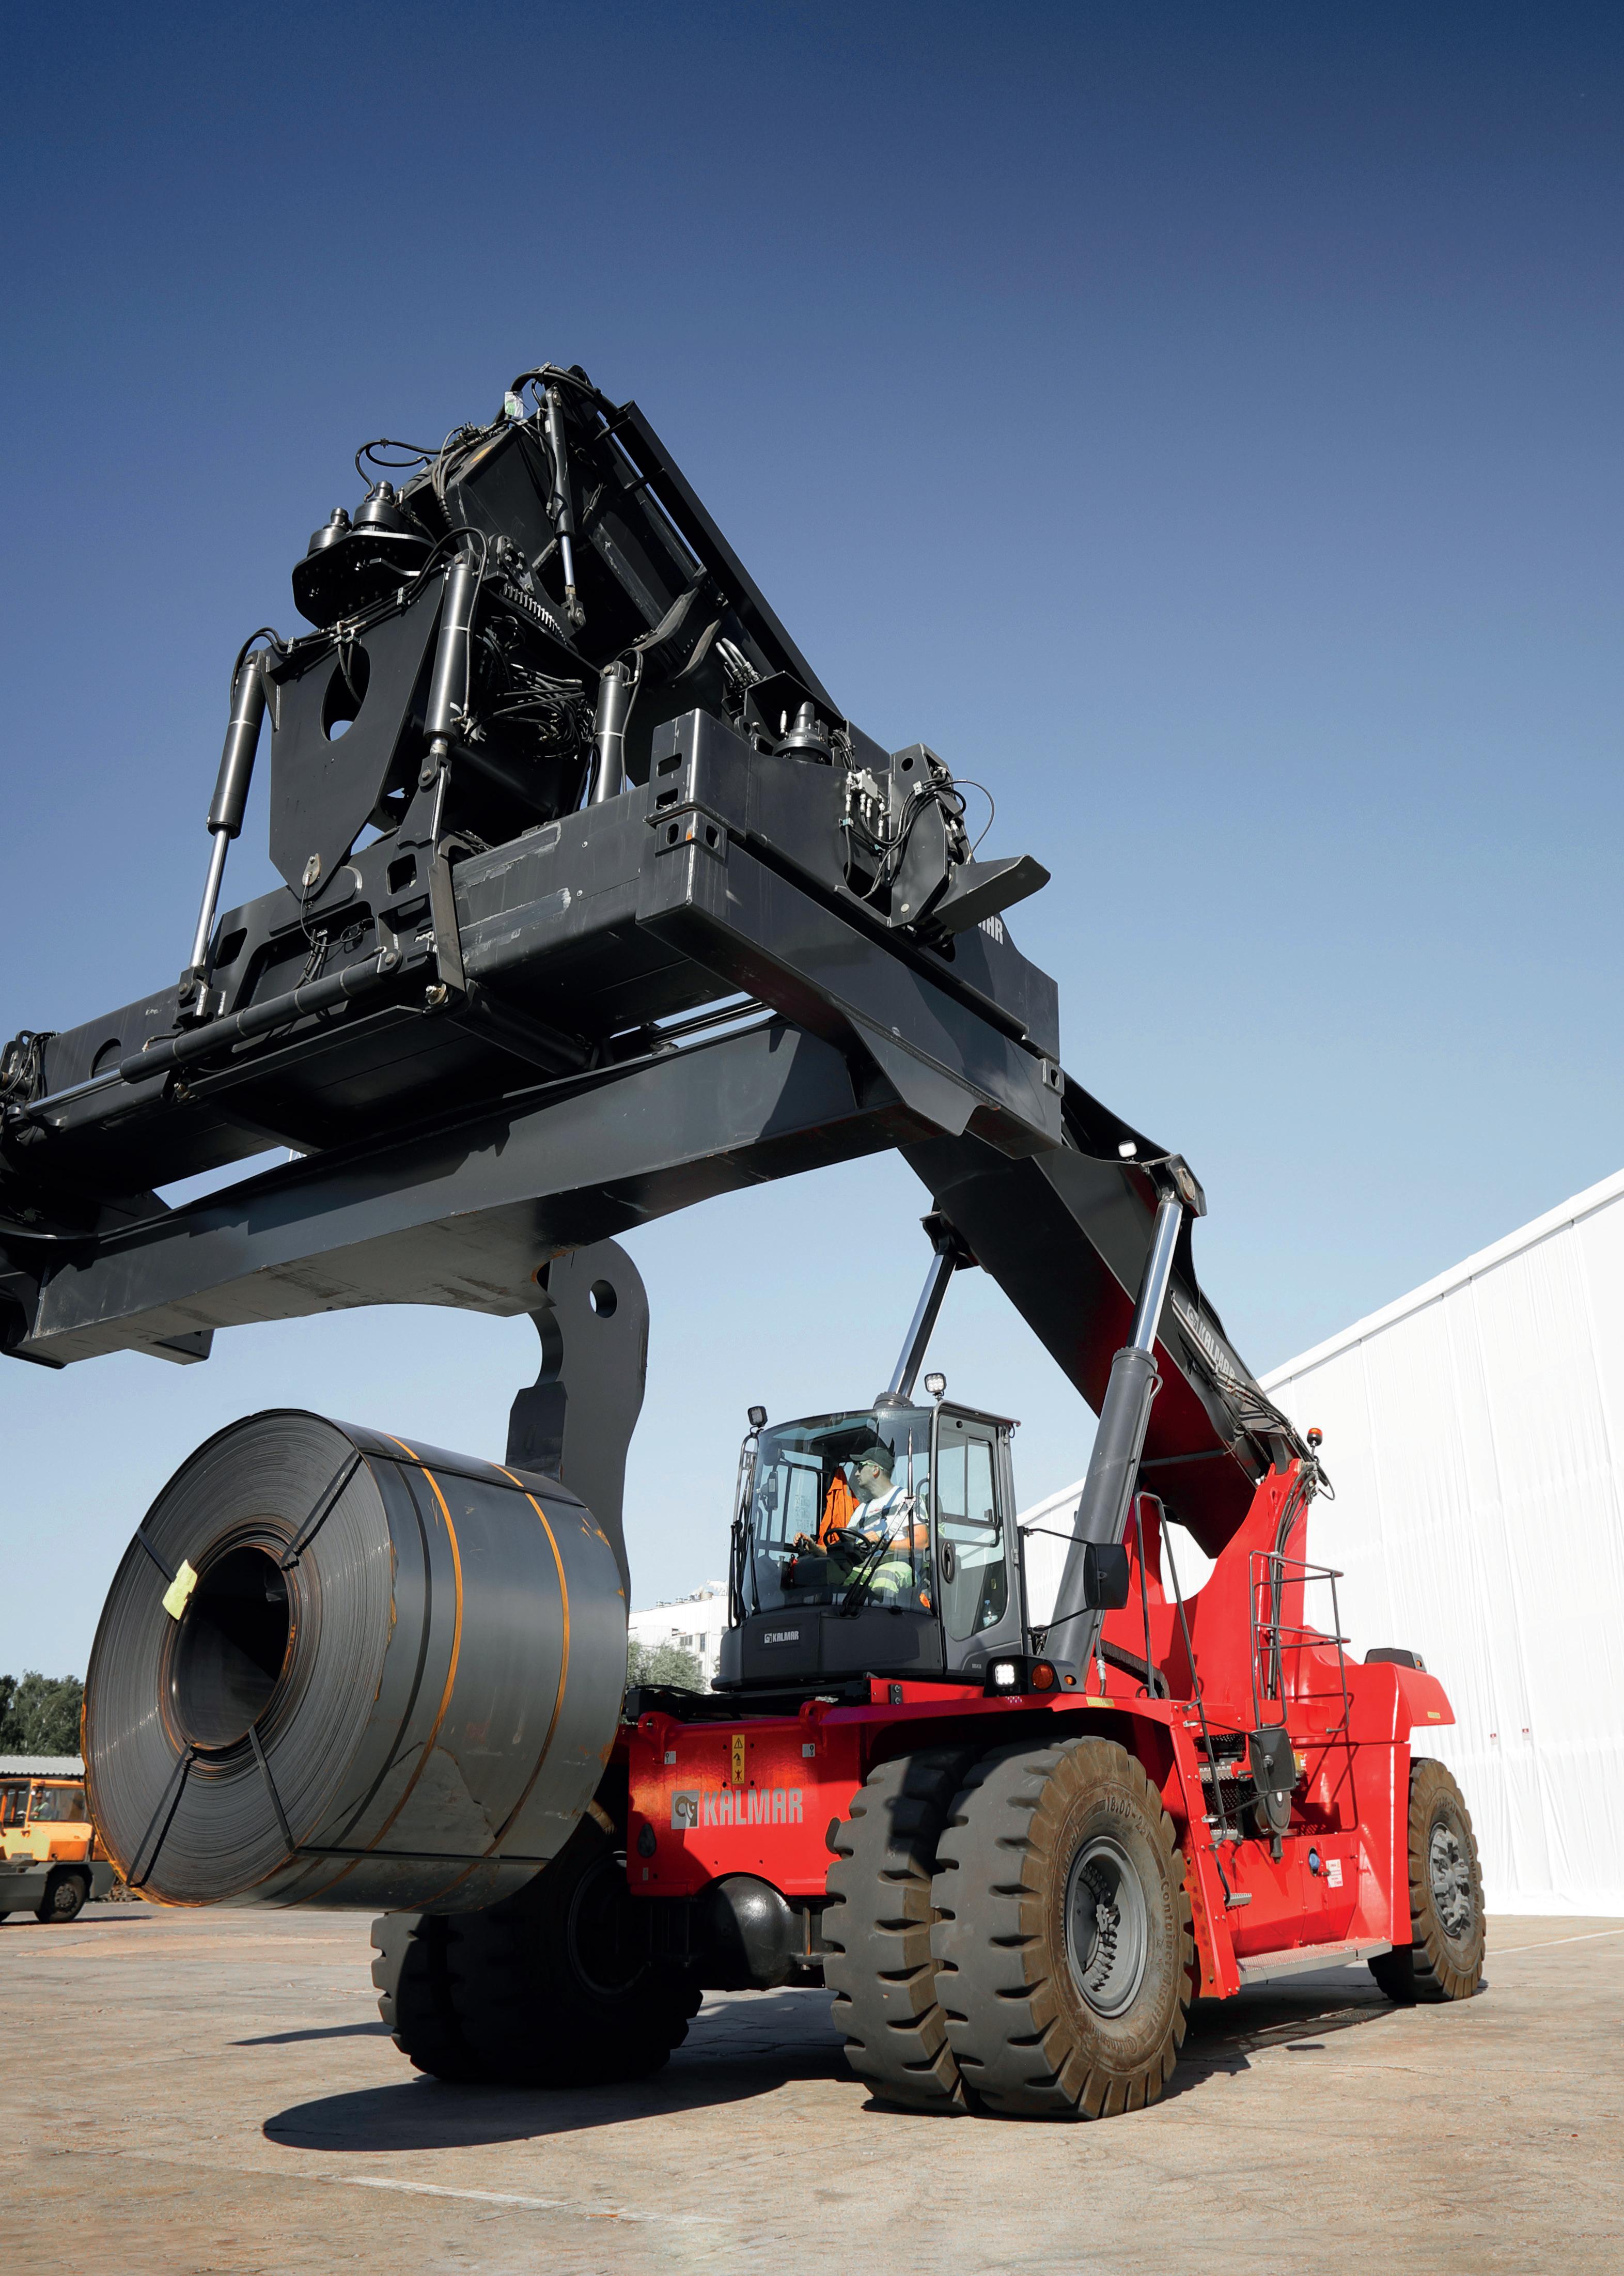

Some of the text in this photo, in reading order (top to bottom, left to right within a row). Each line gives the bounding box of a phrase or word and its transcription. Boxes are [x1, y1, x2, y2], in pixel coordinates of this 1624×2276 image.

[1198, 1321, 1235, 1378] KALMAR
[773, 1631, 799, 1642] KALMAR
[704, 1788, 803, 1826] KALMAR
